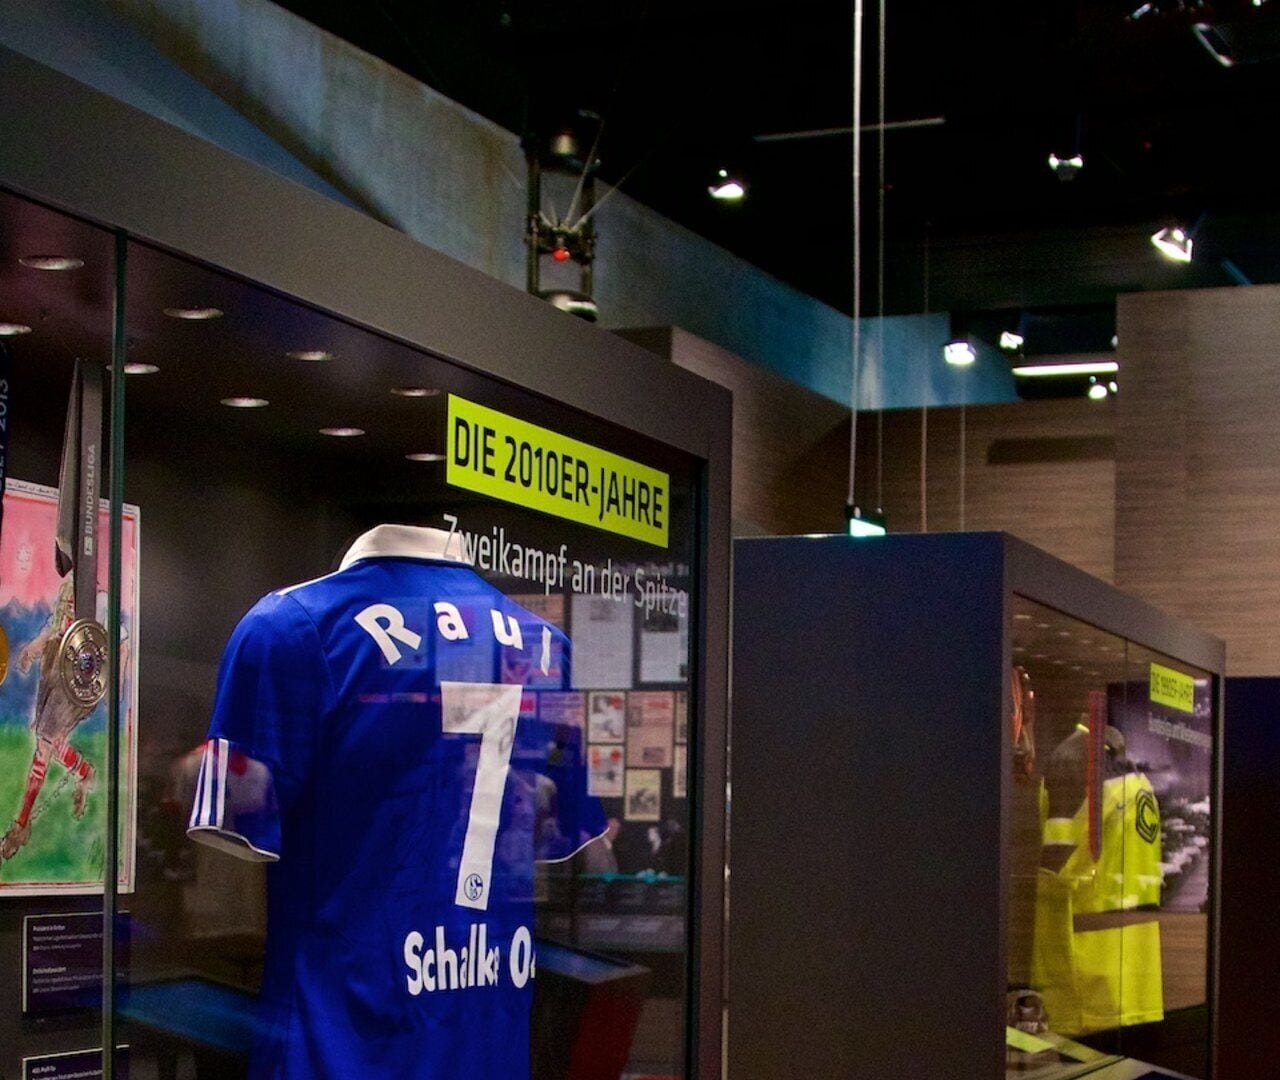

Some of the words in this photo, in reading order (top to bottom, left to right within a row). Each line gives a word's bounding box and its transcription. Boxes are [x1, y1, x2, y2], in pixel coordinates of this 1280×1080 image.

[84, 443, 98, 537] BUNDESLIGA
[454, 416, 496, 478] DIE
[504, 435, 664, 530] 2010ER-JAHRE
[443, 513, 567, 592] Zweikampf
[572, 561, 596, 595] an
[601, 559, 630, 600] der
[634, 567, 689, 621] Spitze
[441, 681, 524, 911] 7
